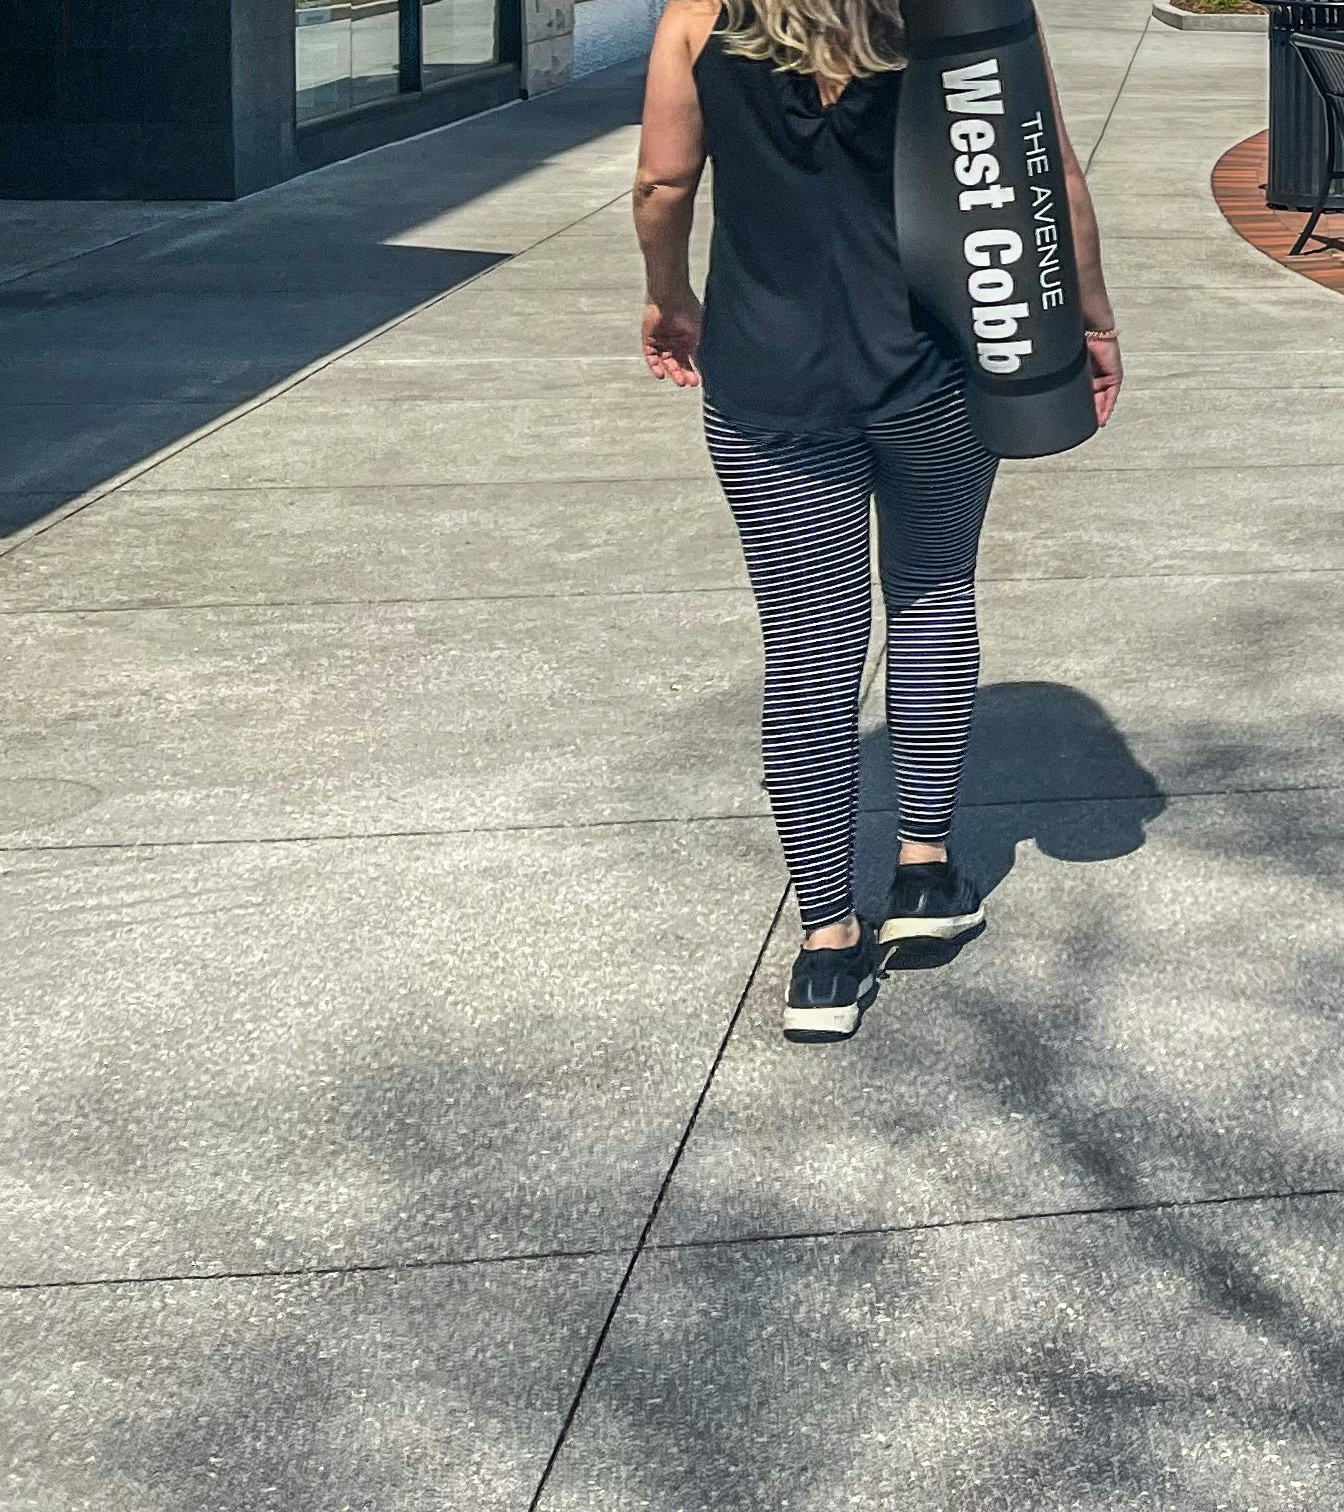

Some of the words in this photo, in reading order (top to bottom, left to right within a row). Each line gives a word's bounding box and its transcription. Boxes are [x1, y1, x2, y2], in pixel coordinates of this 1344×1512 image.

[941, 58, 1015, 212] West
[1021, 111, 1049, 177] THE
[963, 228, 1033, 376] Cobb
[1030, 185, 1066, 311] AVENUE
